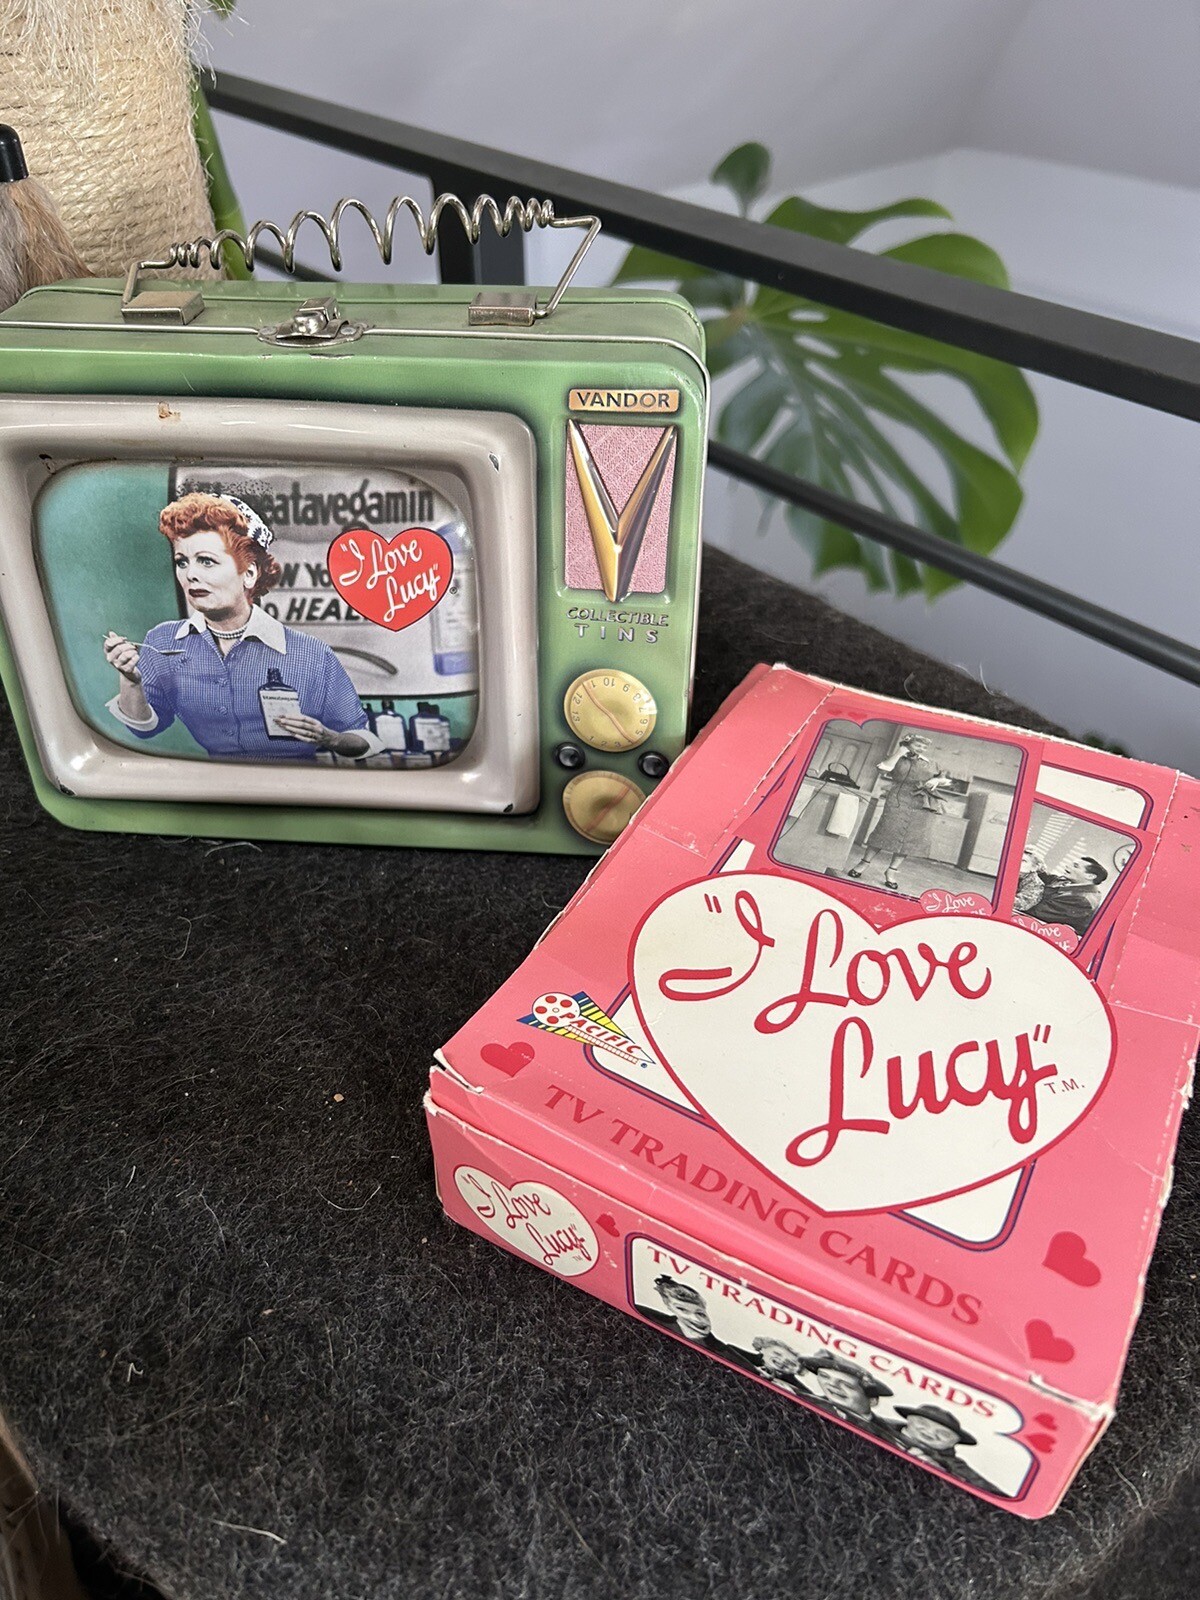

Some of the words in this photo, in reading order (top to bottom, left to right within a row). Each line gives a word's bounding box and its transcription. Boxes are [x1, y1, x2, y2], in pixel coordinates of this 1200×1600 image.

[577, 391, 671, 408] VANDOR
[366, 538, 423, 590] Love
[286, 597, 369, 621] HEAL
[566, 606, 669, 627] COLLECTIBLE
[574, 623, 659, 644] TINS
[942, 894, 976, 914] Love
[753, 908, 991, 1034] Love
[559, 1012, 642, 1054] PACIFIC
[490, 1180, 552, 1230] Love
[545, 1084, 604, 1124] TV
[610, 1118, 811, 1239] TRADING
[819, 1230, 983, 1326] CARDS
[647, 1245, 690, 1275] TV
[699, 1272, 858, 1358] TRADING
[869, 1354, 997, 1418] CARDS
